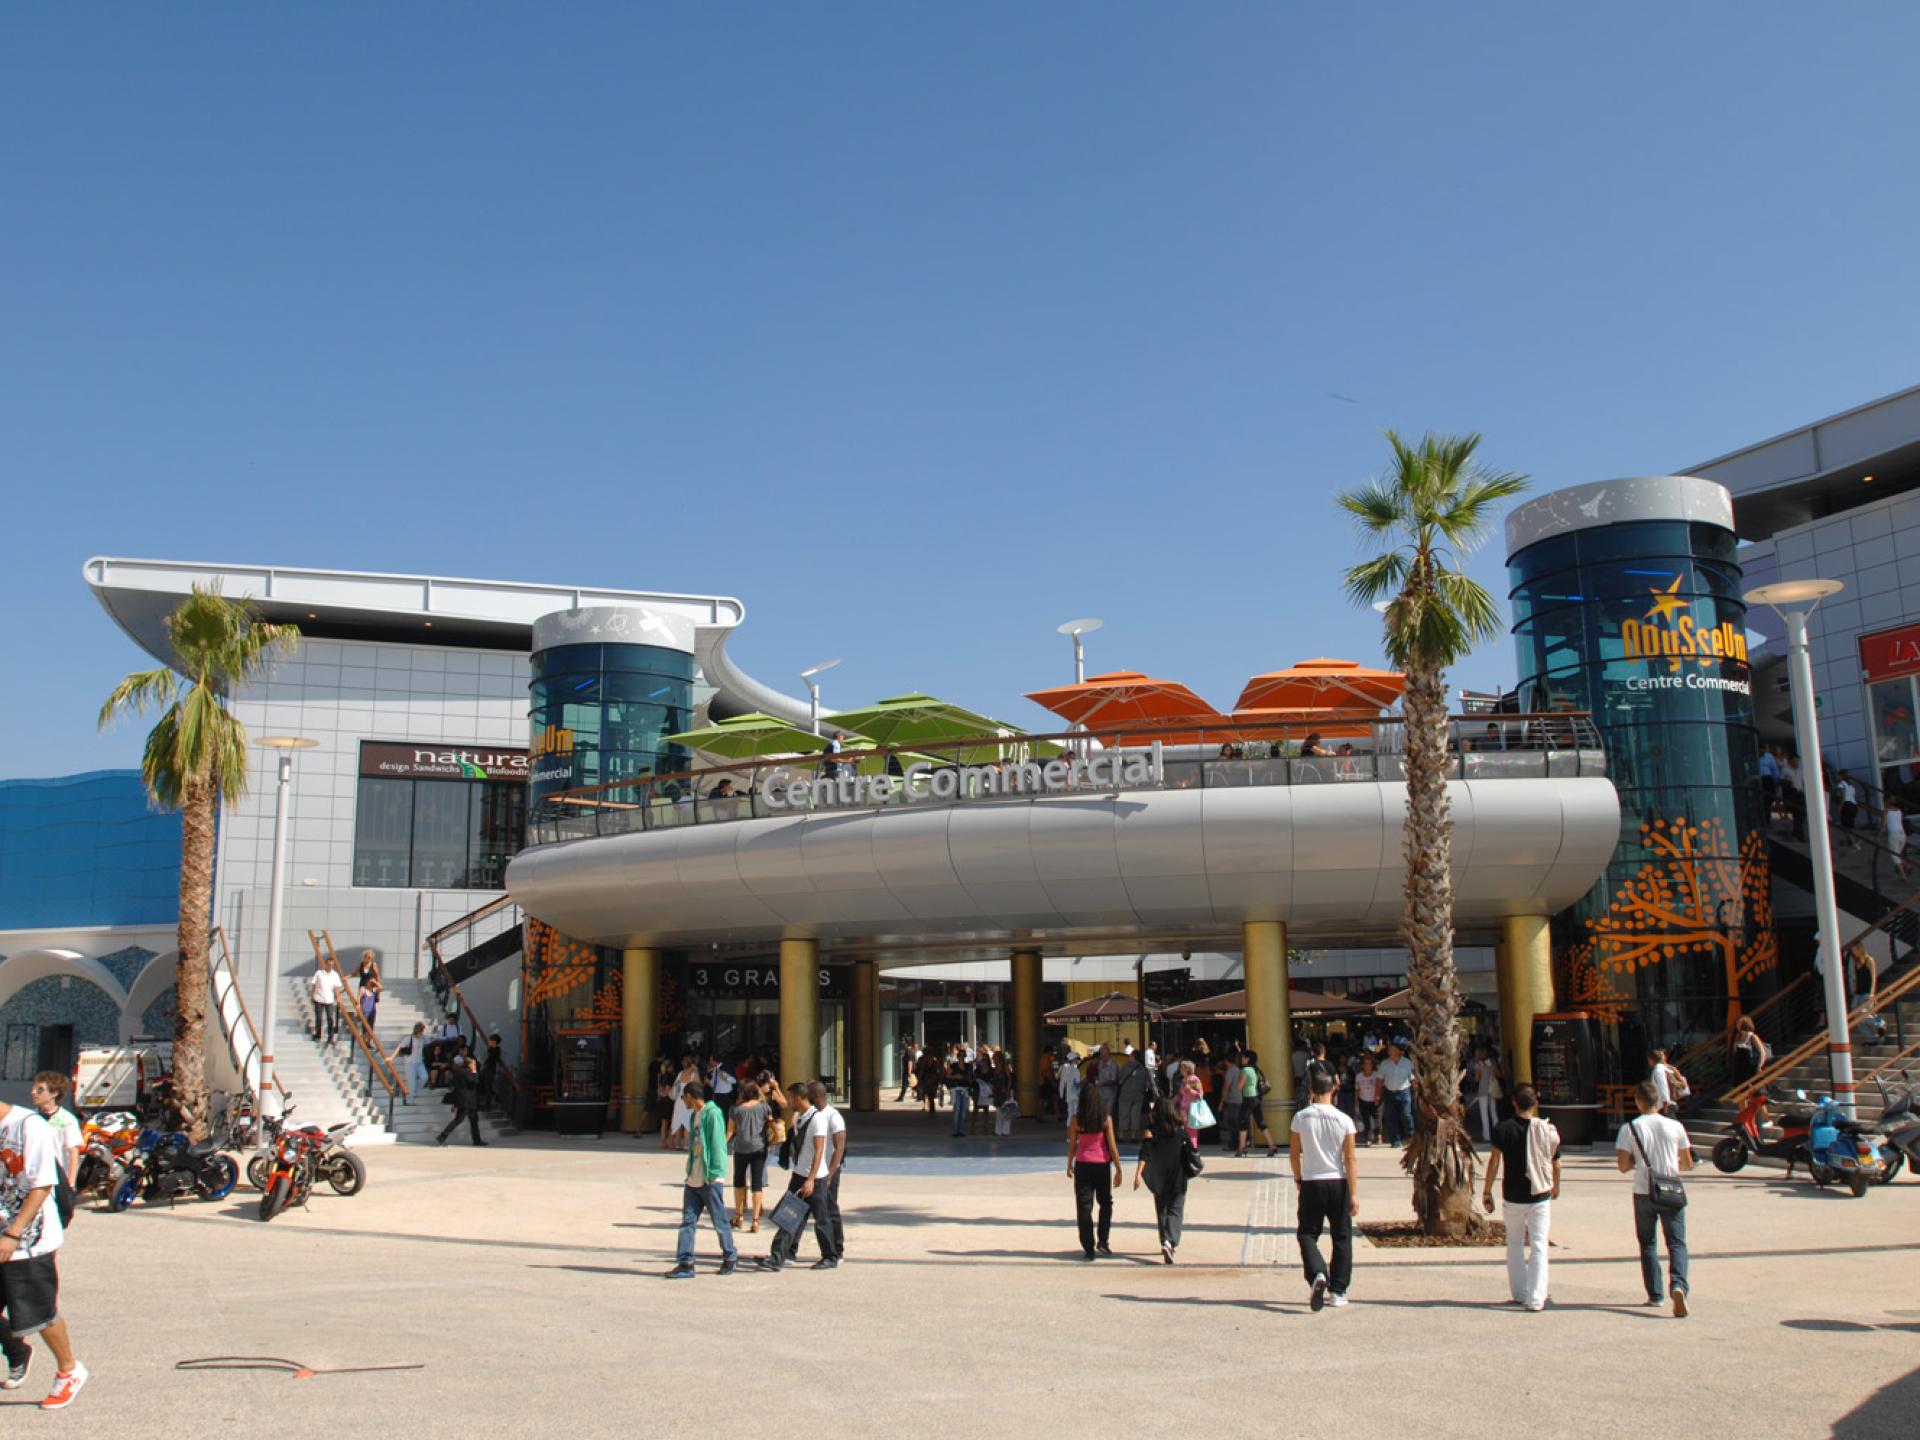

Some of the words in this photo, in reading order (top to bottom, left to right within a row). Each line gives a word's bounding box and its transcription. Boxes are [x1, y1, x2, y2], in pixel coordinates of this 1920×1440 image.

[1626, 674, 1682, 690] Centre
[1686, 673, 1750, 695] Commercial
[379, 761, 409, 772] design
[413, 763, 460, 773] Sandwichs
[762, 768, 893, 808] Centre
[904, 740, 1163, 798] Commercial
[696, 970, 708, 986] 3
[724, 970, 831, 986] GRAS
